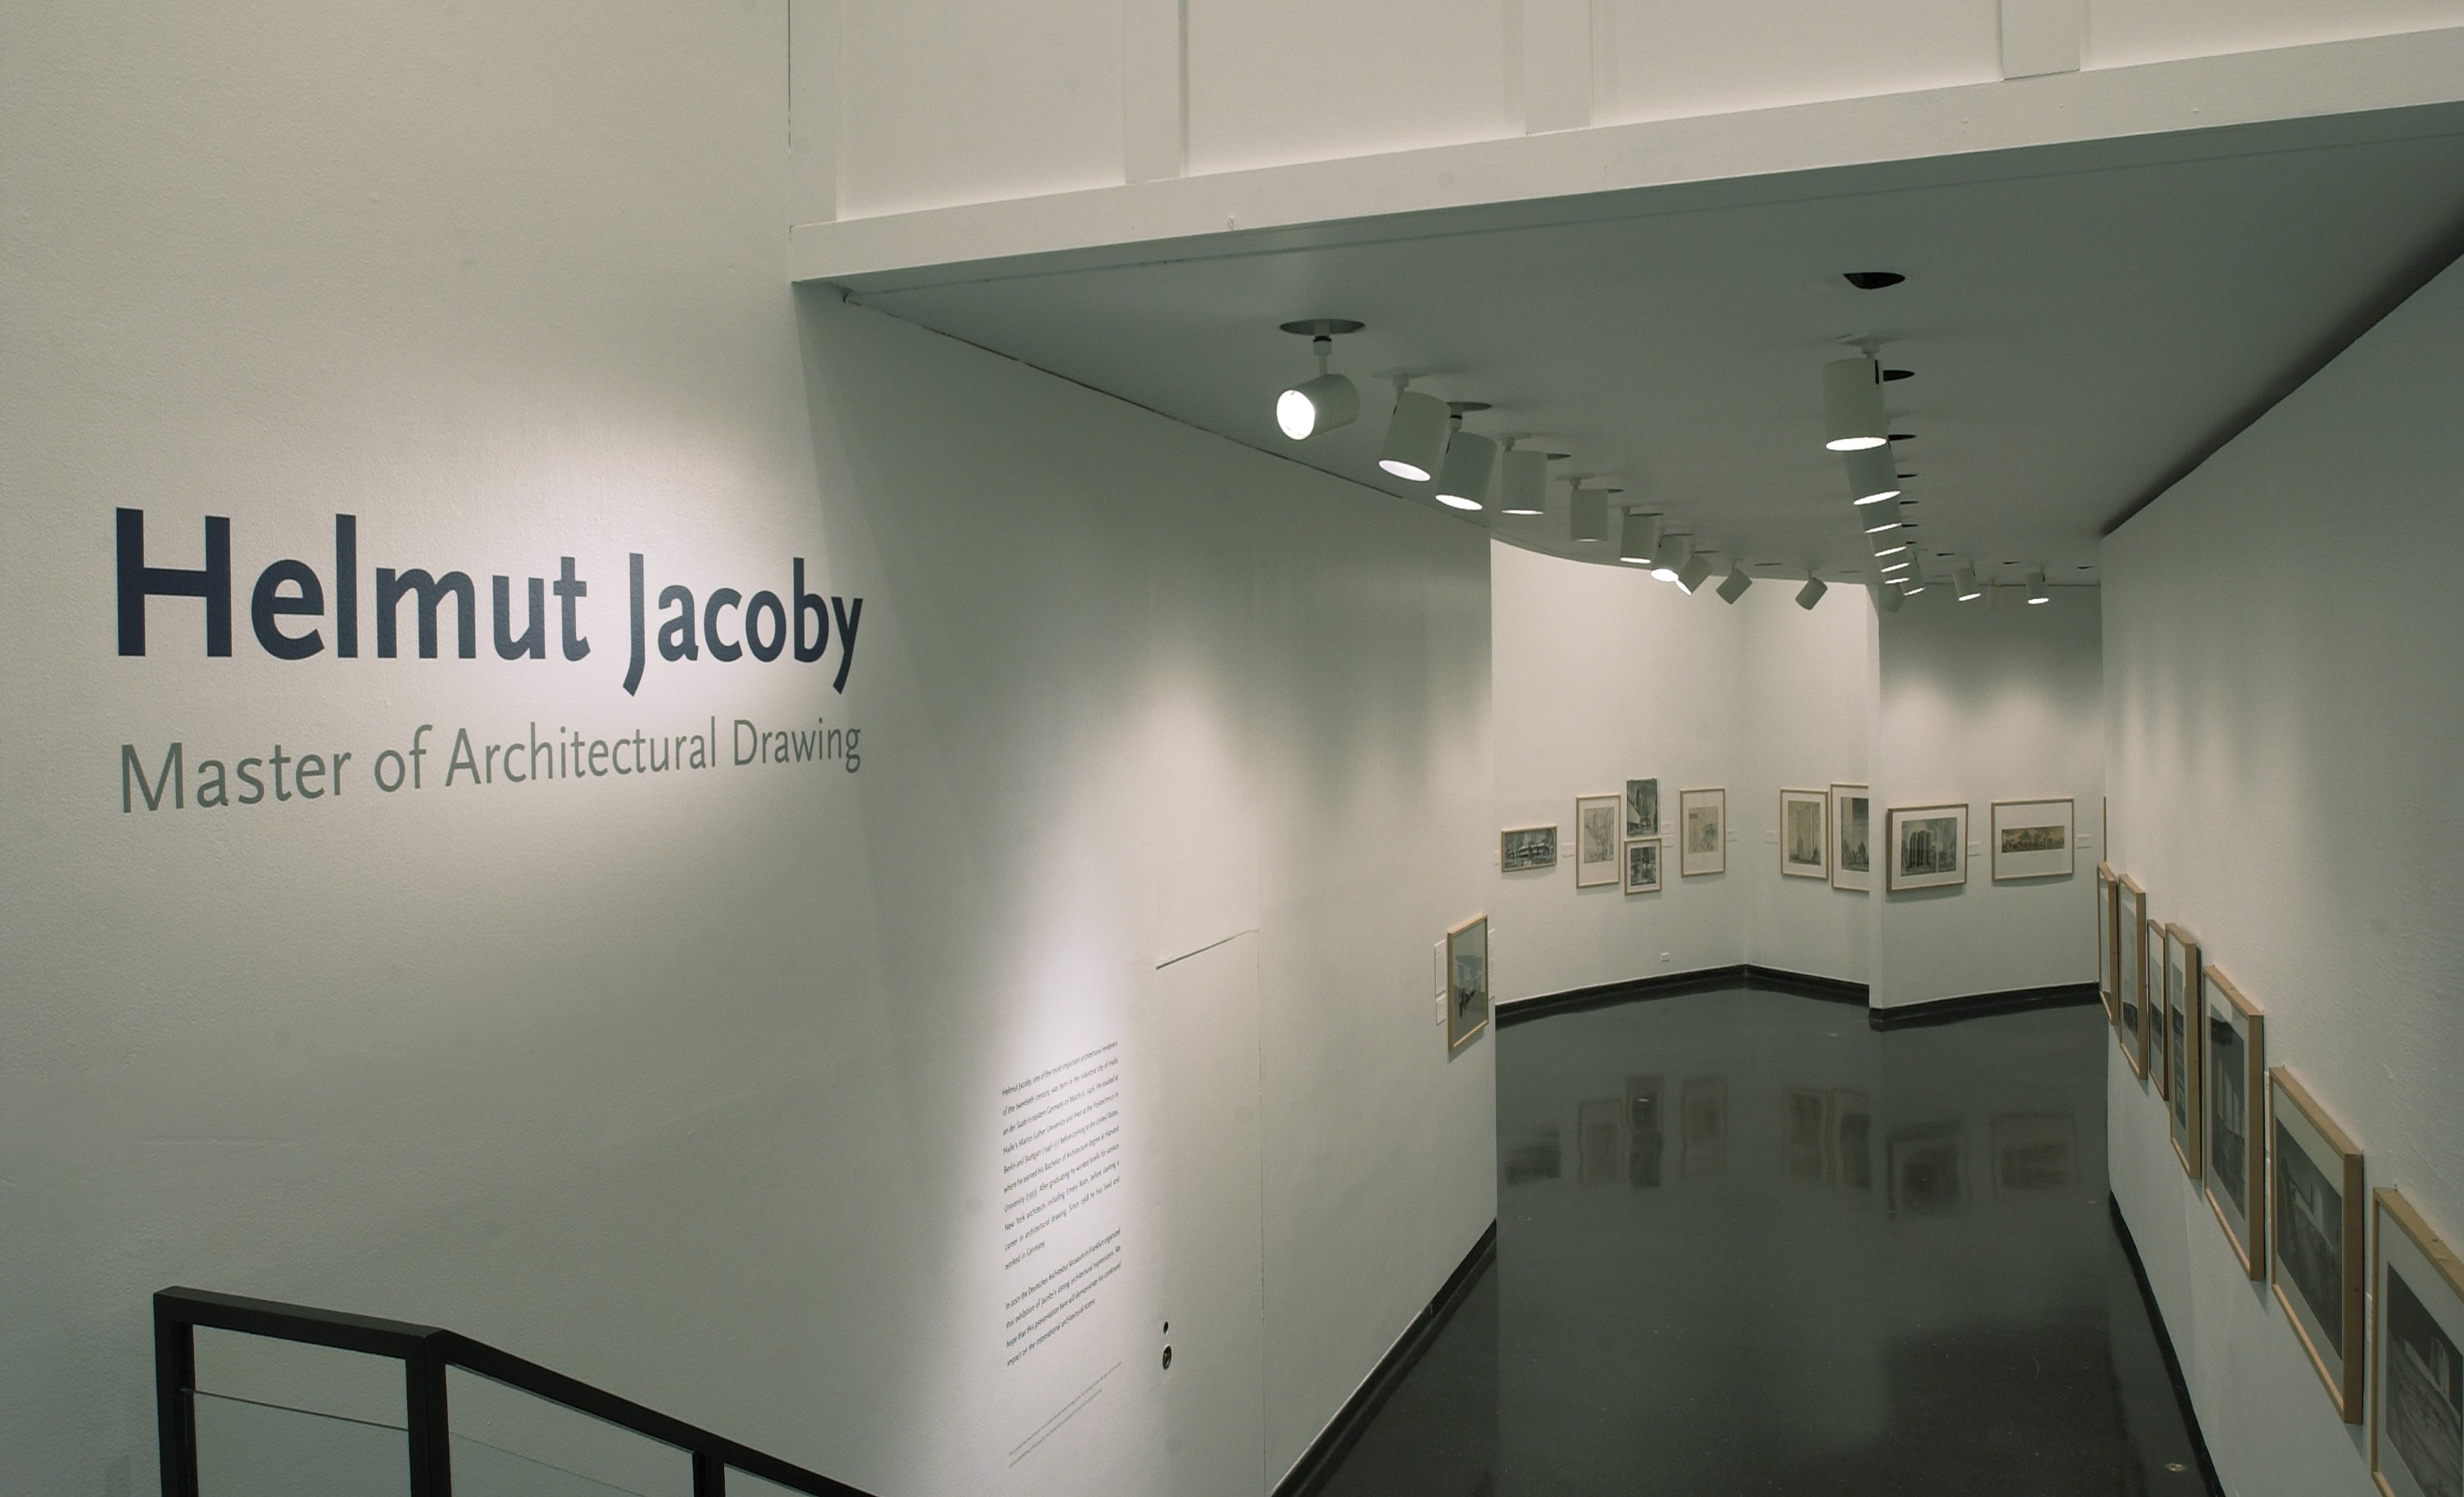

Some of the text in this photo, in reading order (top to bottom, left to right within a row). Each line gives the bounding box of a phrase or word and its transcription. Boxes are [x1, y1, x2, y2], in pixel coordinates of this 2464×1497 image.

[116, 508, 863, 696] Helmut Jacoby
[121, 717, 861, 813] Master of Architectural Drawing
